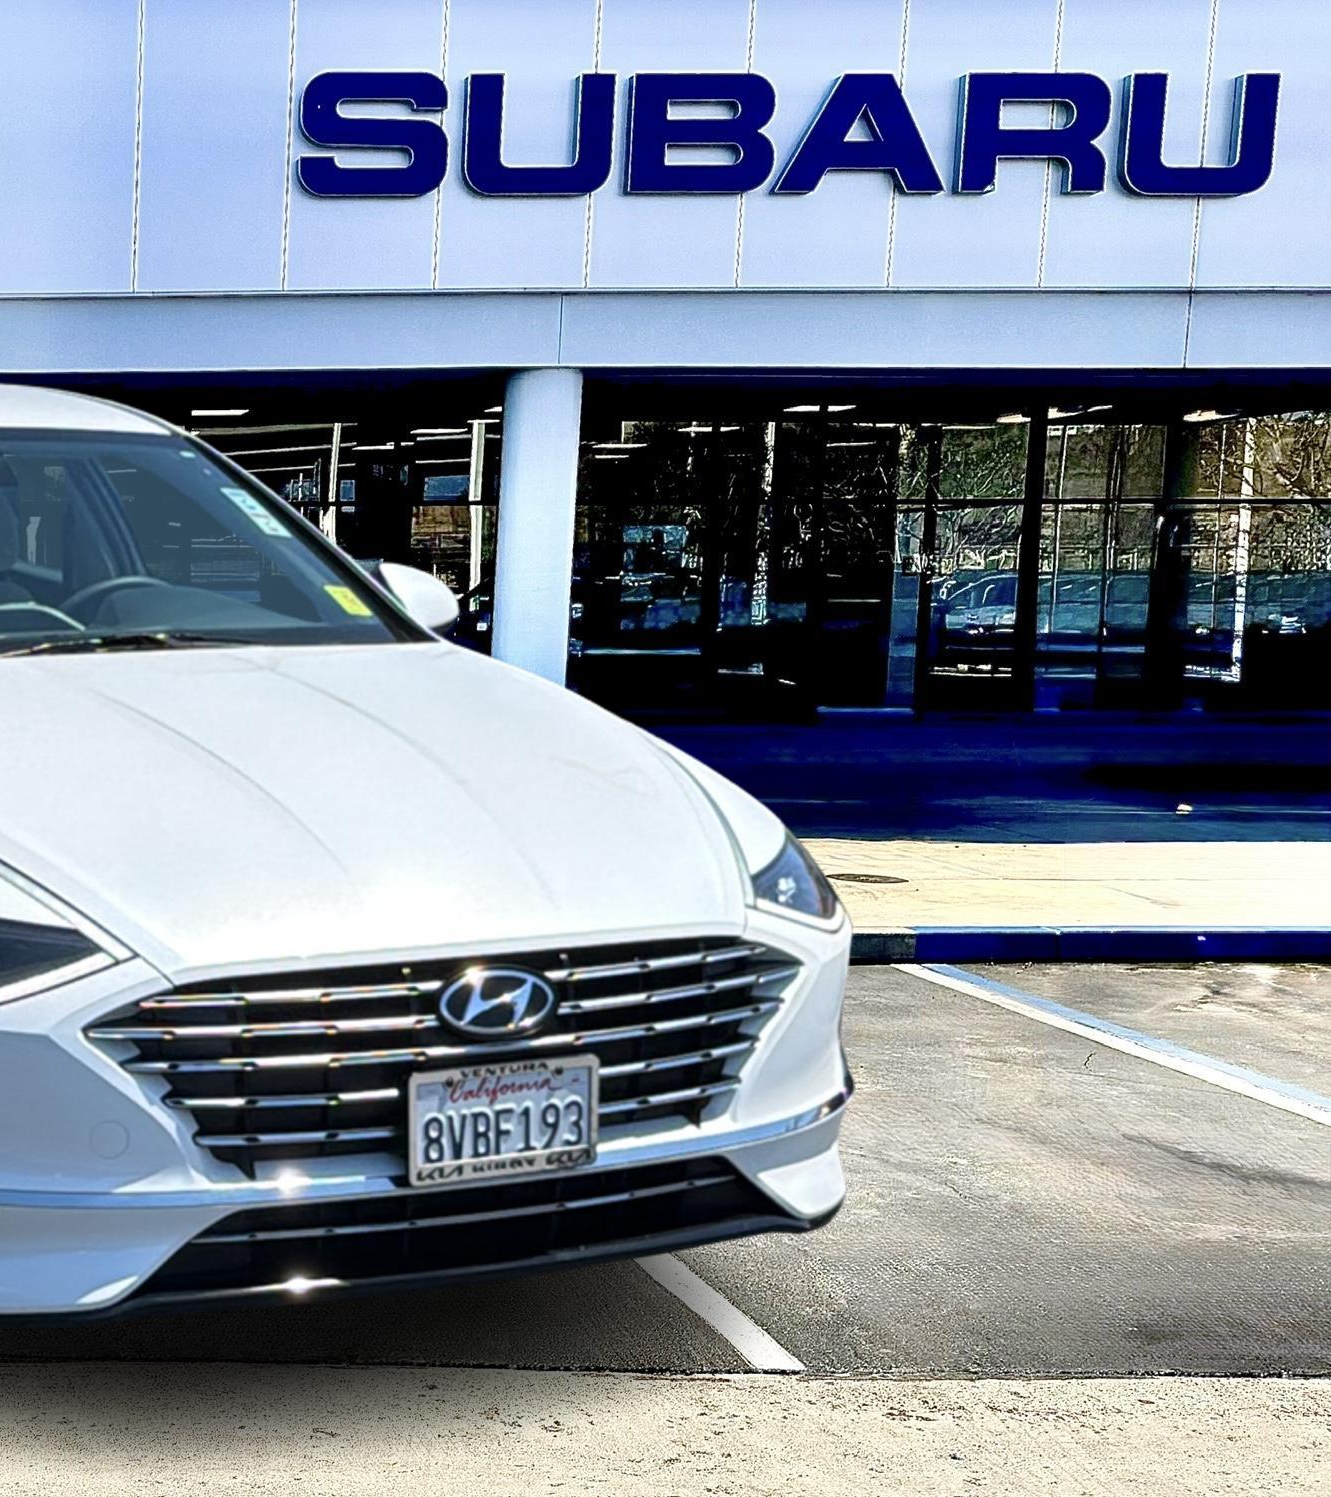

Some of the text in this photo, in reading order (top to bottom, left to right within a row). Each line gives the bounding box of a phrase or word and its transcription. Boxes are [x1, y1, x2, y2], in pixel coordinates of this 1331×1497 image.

[297, 71, 1281, 198] SUBARU
[450, 1075, 563, 1105] California
[460, 1061, 550, 1079] VENTURA
[423, 1098, 584, 1165] 8VBF193
